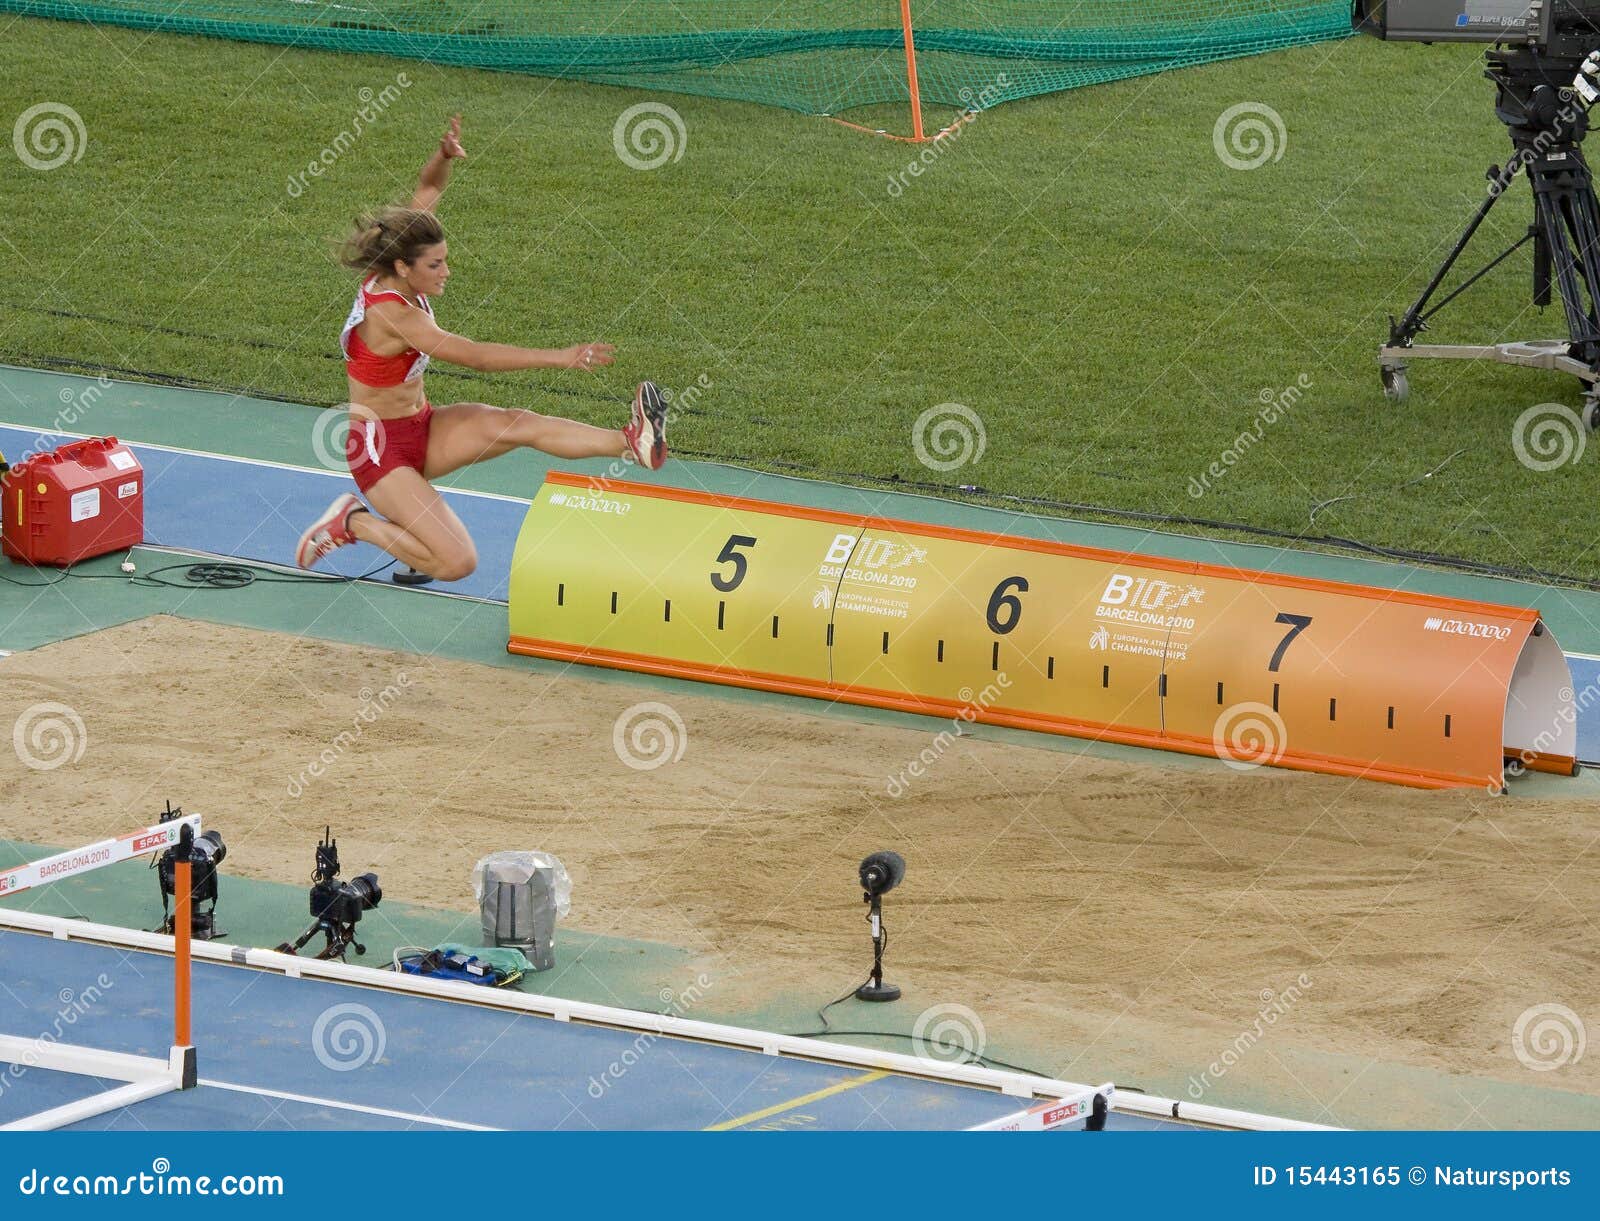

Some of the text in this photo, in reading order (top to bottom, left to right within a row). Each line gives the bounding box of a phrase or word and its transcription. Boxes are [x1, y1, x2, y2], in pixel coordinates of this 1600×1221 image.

[710, 534, 757, 592] 5
[818, 565, 917, 589] BARCELONA 2010
[835, 600, 908, 619] CHAMPIONSHIPS
[986, 576, 1029, 635] 6
[1095, 605, 1195, 630] BARCELONA 2010
[1112, 633, 1149, 645] EUROPEAN
[1442, 619, 1512, 640] MONDO
[1111, 641, 1187, 660] CHAMPIONSHIPS
[1268, 612, 1313, 672] 7
[139, 831, 168, 849] SPAR
[40, 849, 110, 878] BARCELONA 2010
[1049, 1104, 1078, 1121] SPAR
